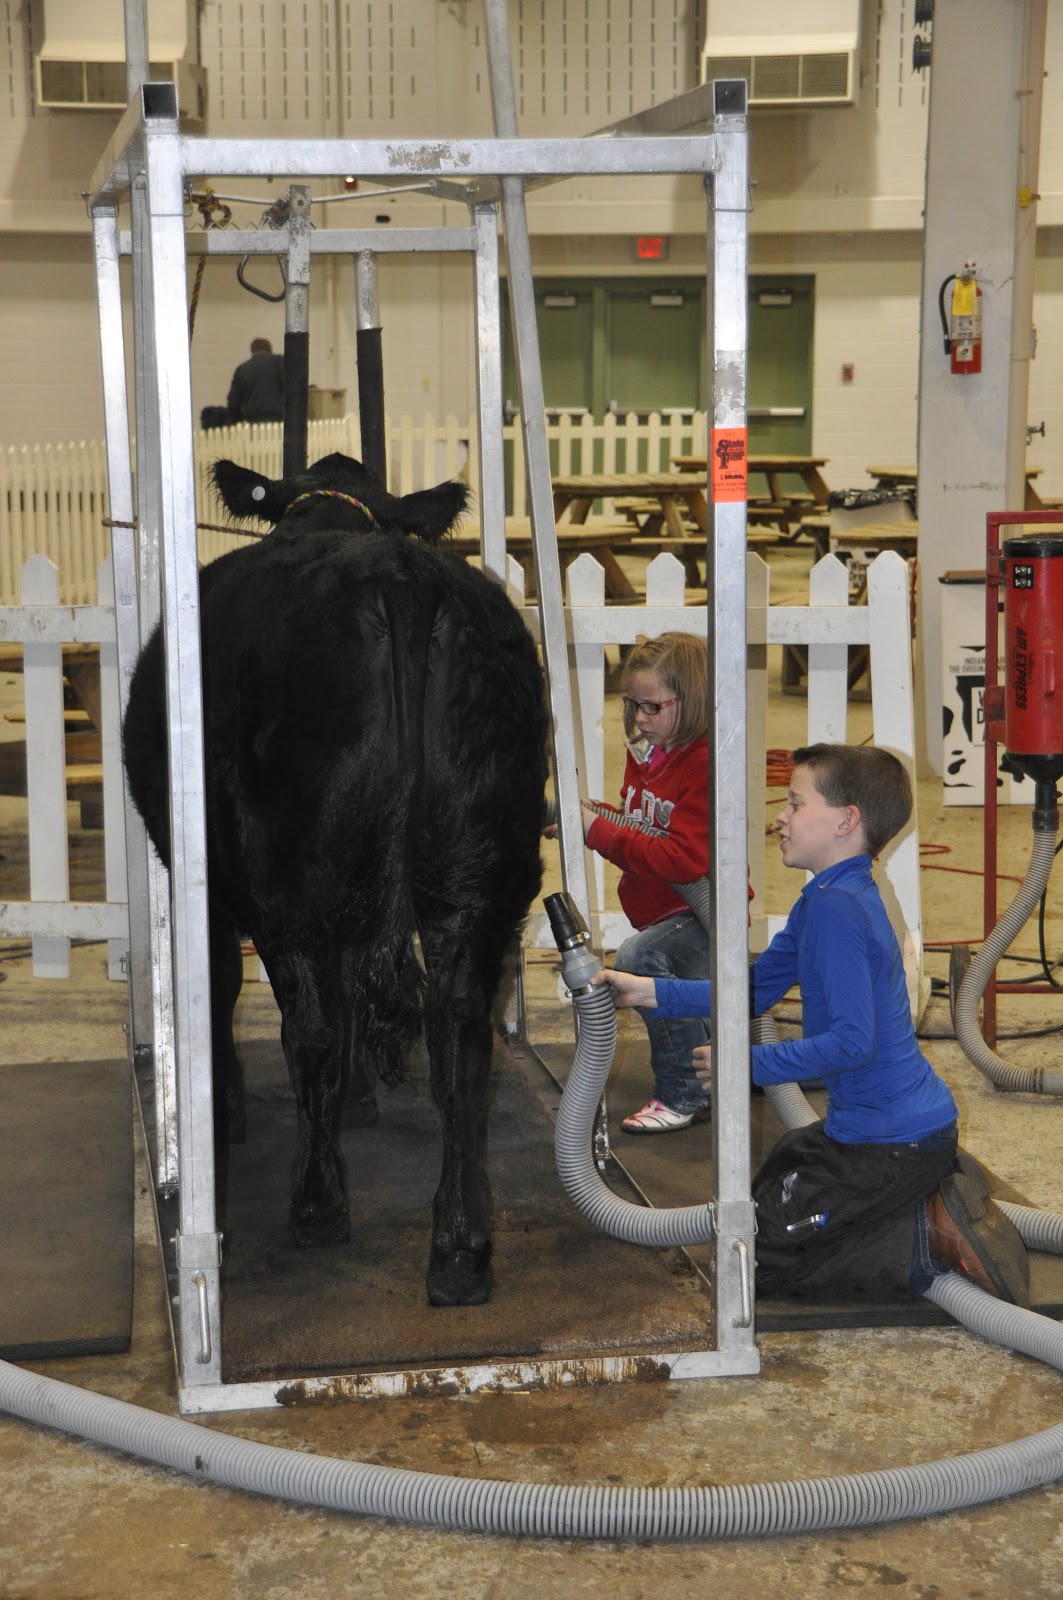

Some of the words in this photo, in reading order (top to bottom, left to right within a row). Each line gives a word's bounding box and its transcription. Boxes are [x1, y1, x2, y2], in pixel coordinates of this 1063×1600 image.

[1016, 626, 1028, 651] AIR
[949, 665, 960, 673] THE
[962, 664, 985, 673] ORIGIN
[964, 656, 985, 664] INDIAN
[1015, 652, 1028, 711] EXPRESS
